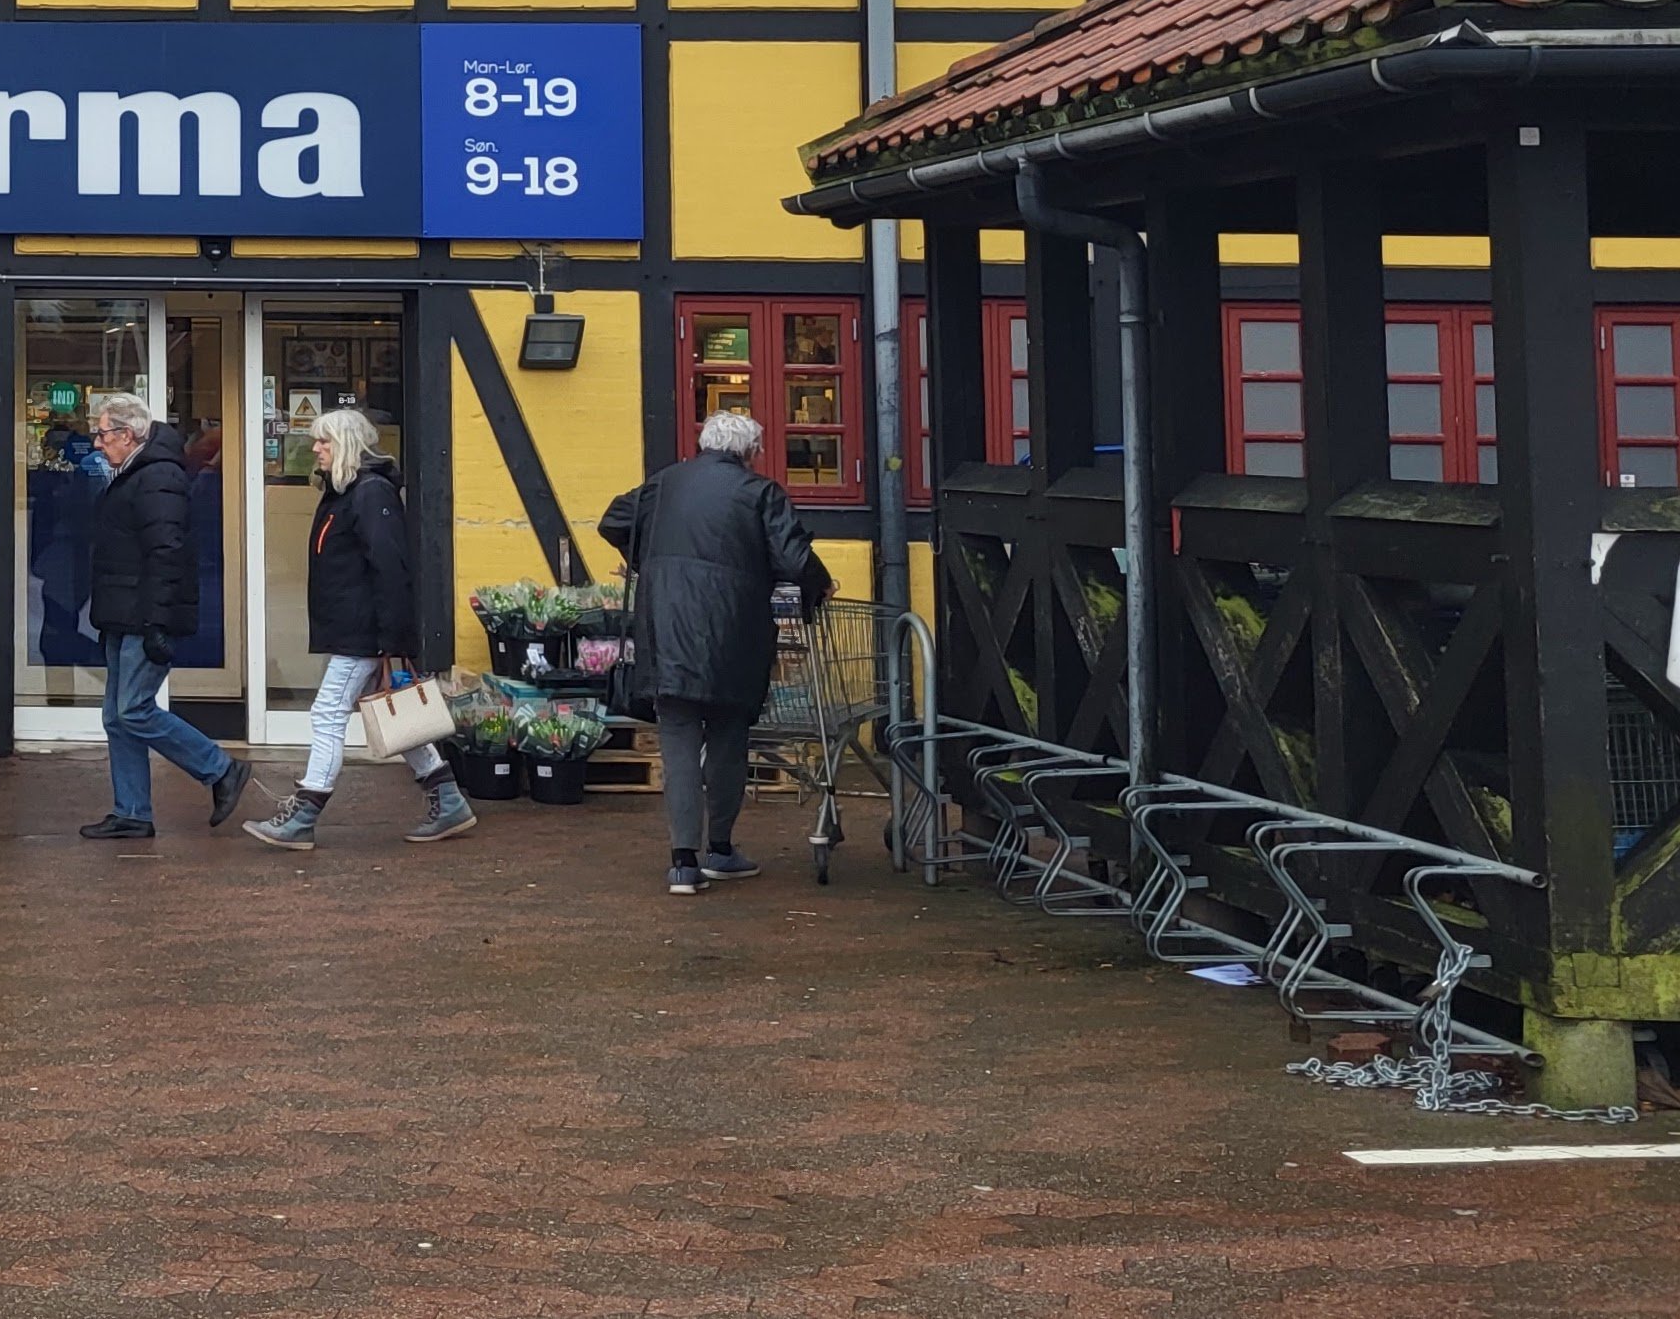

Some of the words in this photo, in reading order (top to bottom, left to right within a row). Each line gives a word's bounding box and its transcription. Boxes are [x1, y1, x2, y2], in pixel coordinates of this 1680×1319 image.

[464, 60, 535, 74] Man-Lør.
[465, 78, 577, 116] 8-19
[464, 138, 499, 153] Søn.
[466, 156, 579, 196] 9-18
[52, 390, 75, 404] IND
